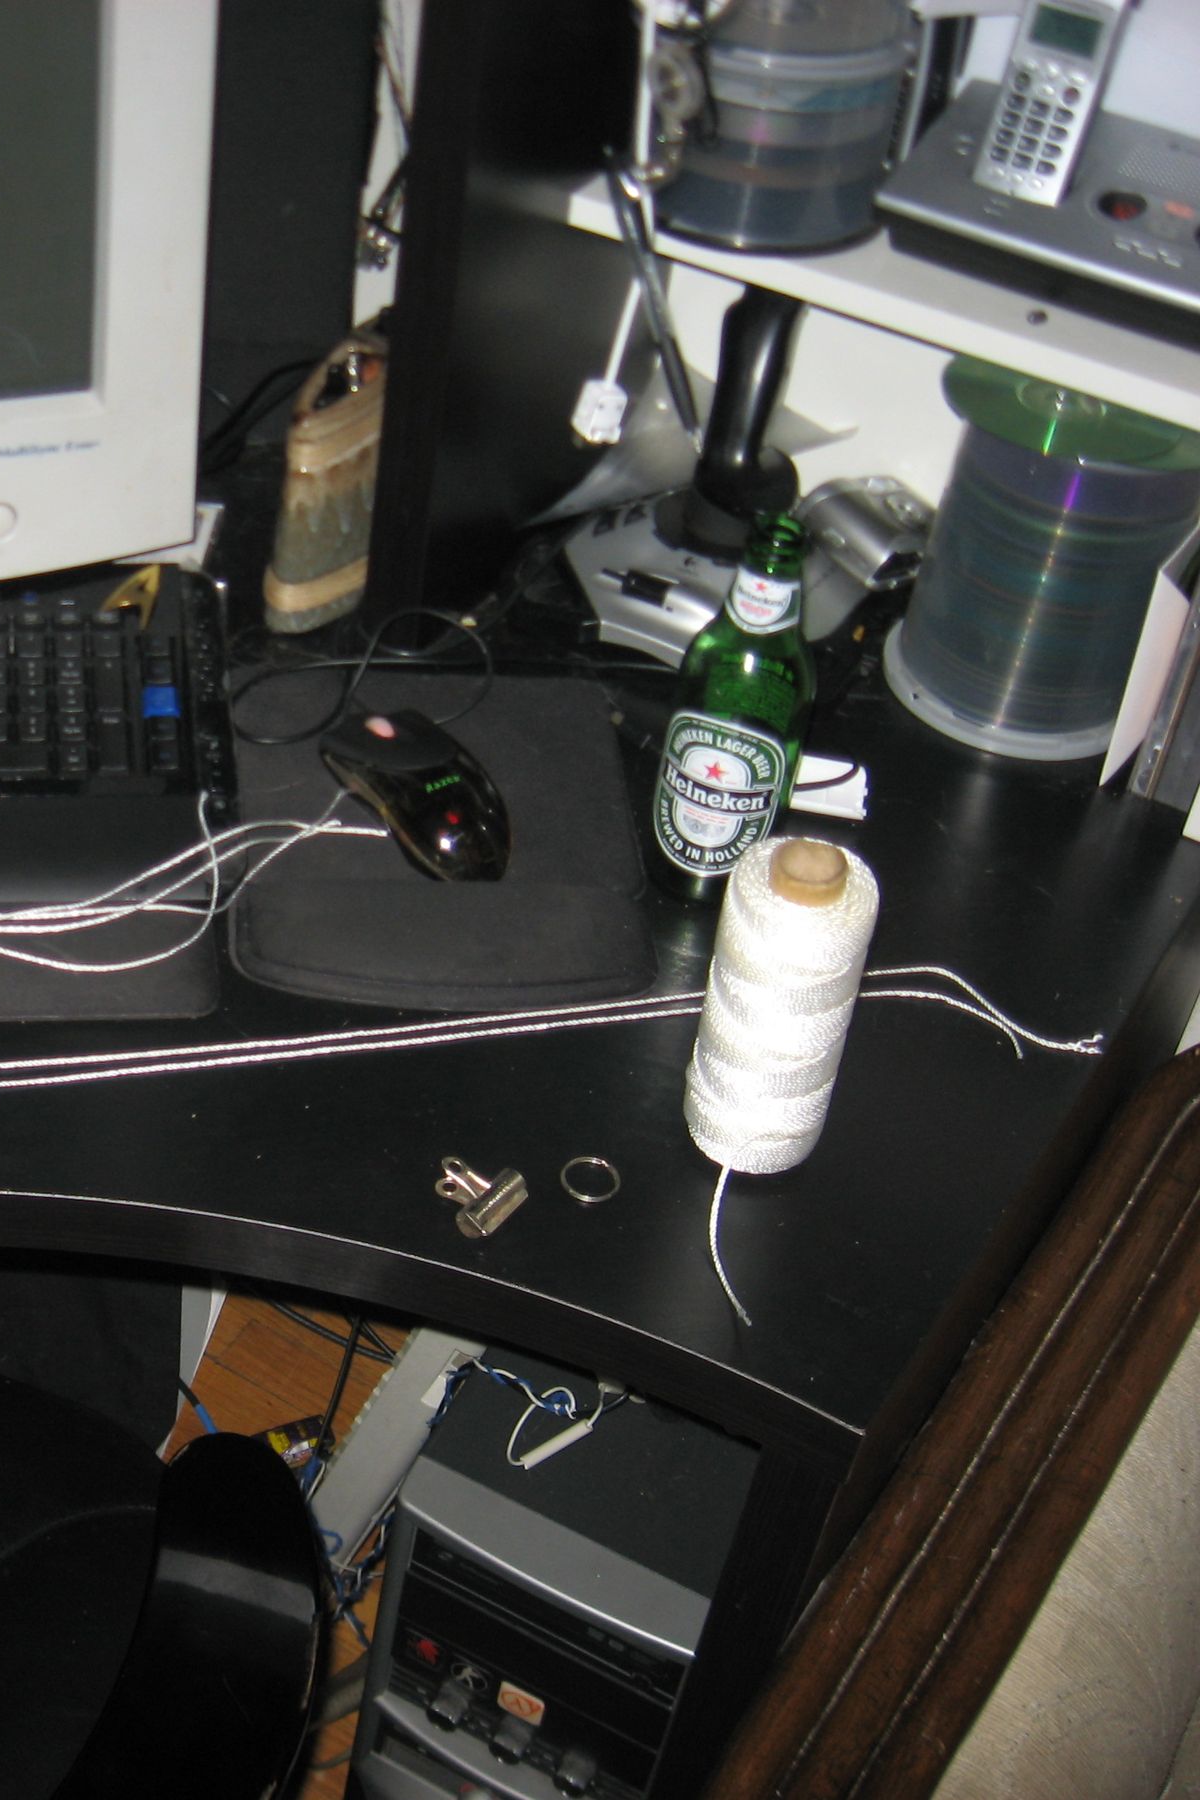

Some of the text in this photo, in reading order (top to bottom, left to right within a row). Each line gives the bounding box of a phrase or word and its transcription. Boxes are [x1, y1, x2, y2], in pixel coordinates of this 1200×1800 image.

[717, 735, 757, 760] LAGER
[752, 752, 771, 780] BEER
[665, 762, 765, 812] Heineken
[660, 799, 684, 851] BREWED
[685, 846, 701, 861] IN
[704, 826, 758, 863] HOLLAND
